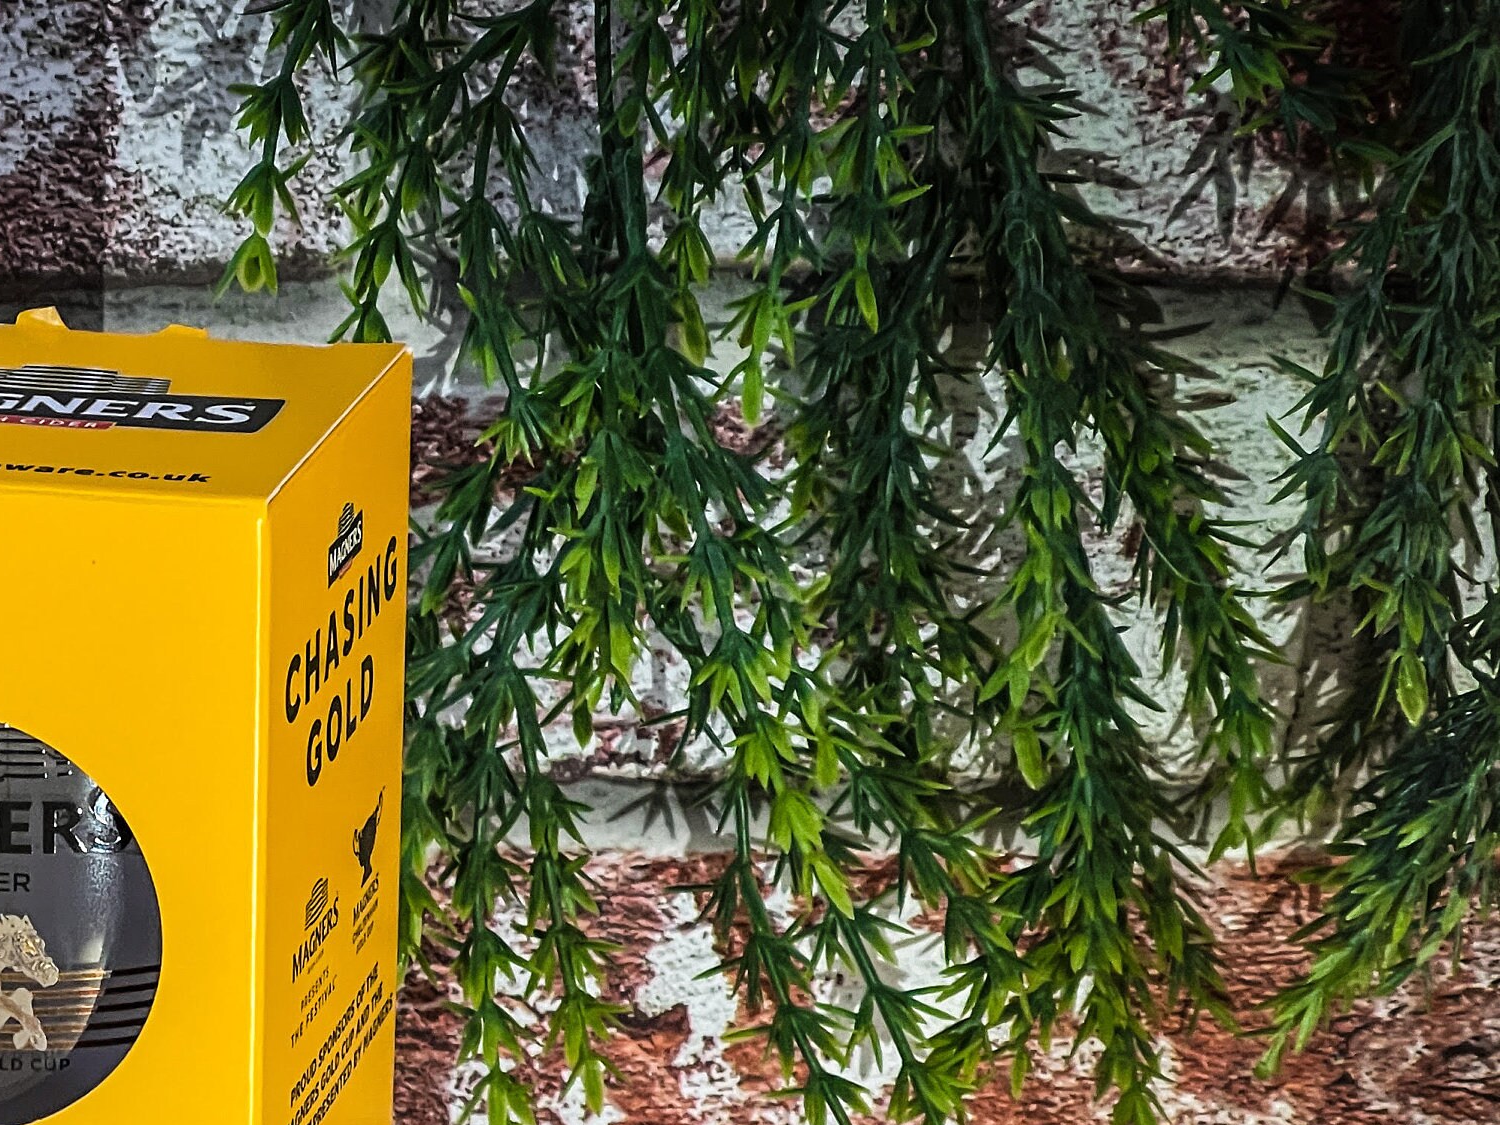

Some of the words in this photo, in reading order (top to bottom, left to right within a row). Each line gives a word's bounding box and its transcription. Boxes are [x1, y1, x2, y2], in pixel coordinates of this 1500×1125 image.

[285, 535, 398, 724] CHASING
[306, 654, 374, 787] GOLD
[292, 897, 339, 984] MAGNERS
[30, 1057, 71, 1072] CUP
[290, 1058, 317, 1108] PROUD
[320, 1050, 340, 1091] GOLD
